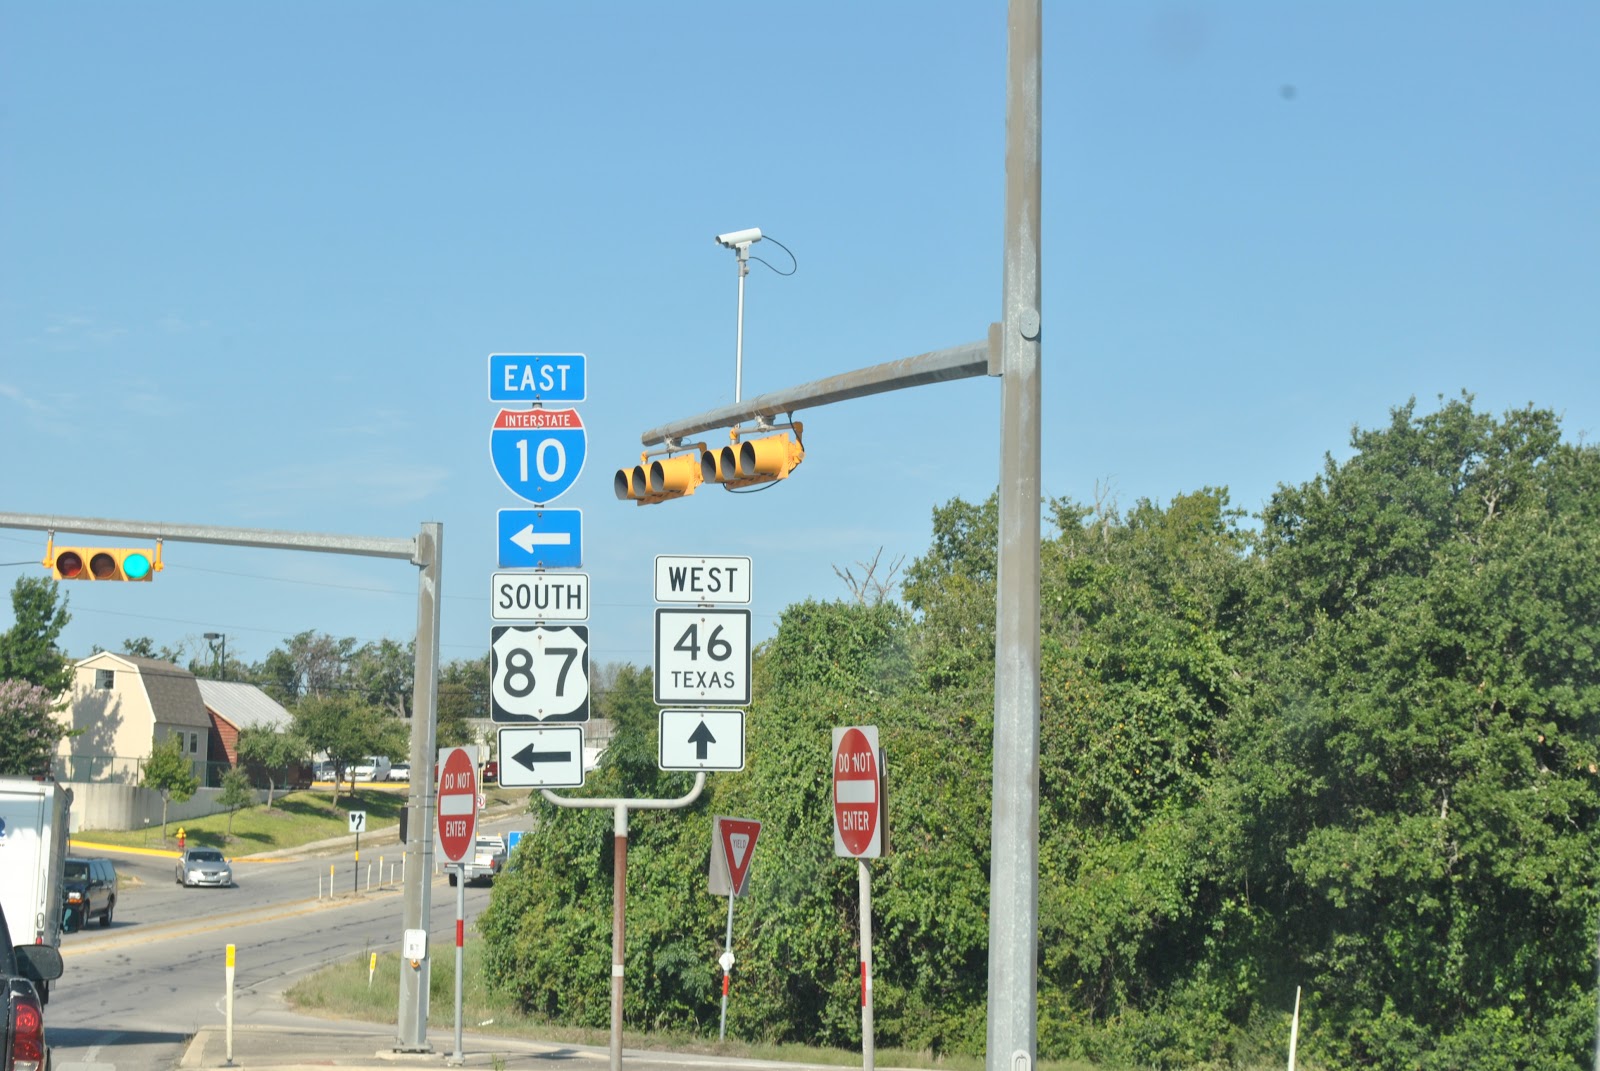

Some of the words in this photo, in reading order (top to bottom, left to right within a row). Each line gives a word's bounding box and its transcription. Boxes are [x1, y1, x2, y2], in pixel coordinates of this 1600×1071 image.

[504, 364, 571, 391] EAST
[505, 414, 571, 427] INTERSTATE
[516, 438, 566, 482] 10
[668, 566, 738, 593] WEST
[499, 583, 581, 610] SOUTH
[673, 623, 732, 661] 46
[503, 647, 578, 698] 87
[671, 671, 735, 689] TEXAS
[838, 753, 850, 773] DO
[853, 752, 871, 773] NOT
[445, 773, 454, 790] DO
[457, 772, 471, 789] NOT
[445, 820, 467, 837] ENTER
[842, 811, 869, 831] ENTER
[733, 839, 747, 849] YIELD
